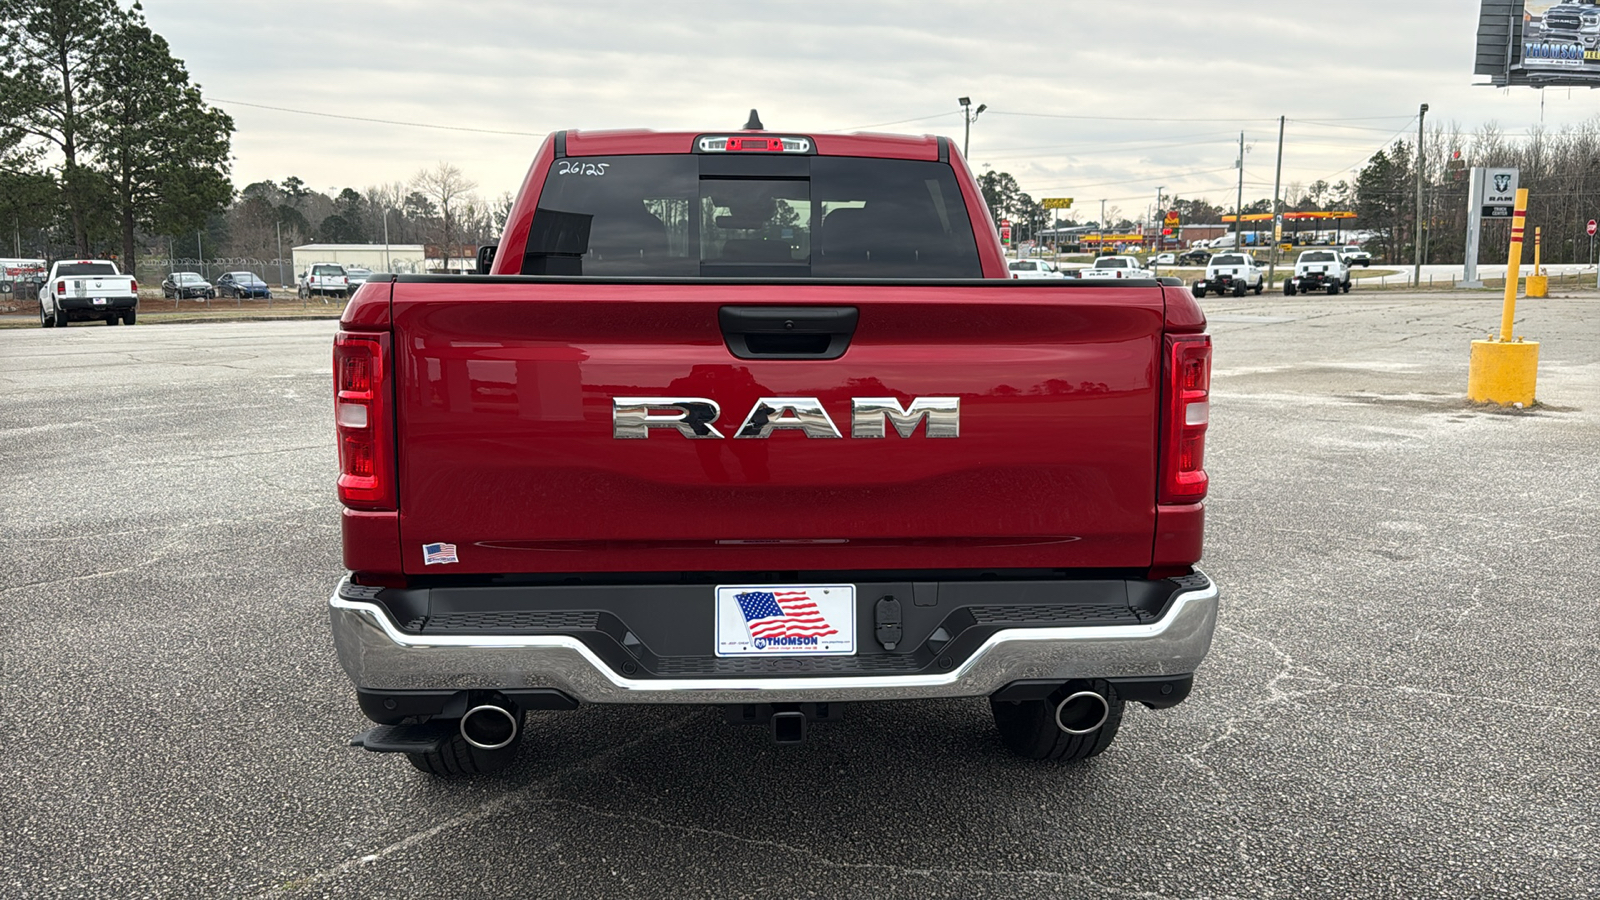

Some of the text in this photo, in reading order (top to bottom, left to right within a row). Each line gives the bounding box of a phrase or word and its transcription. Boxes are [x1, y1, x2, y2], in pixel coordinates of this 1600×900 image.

[1525, 43, 1585, 59] THOMSON
[558, 161, 610, 176] 26125
[612, 396, 961, 439] RAM
[768, 637, 818, 646] THOMSON
